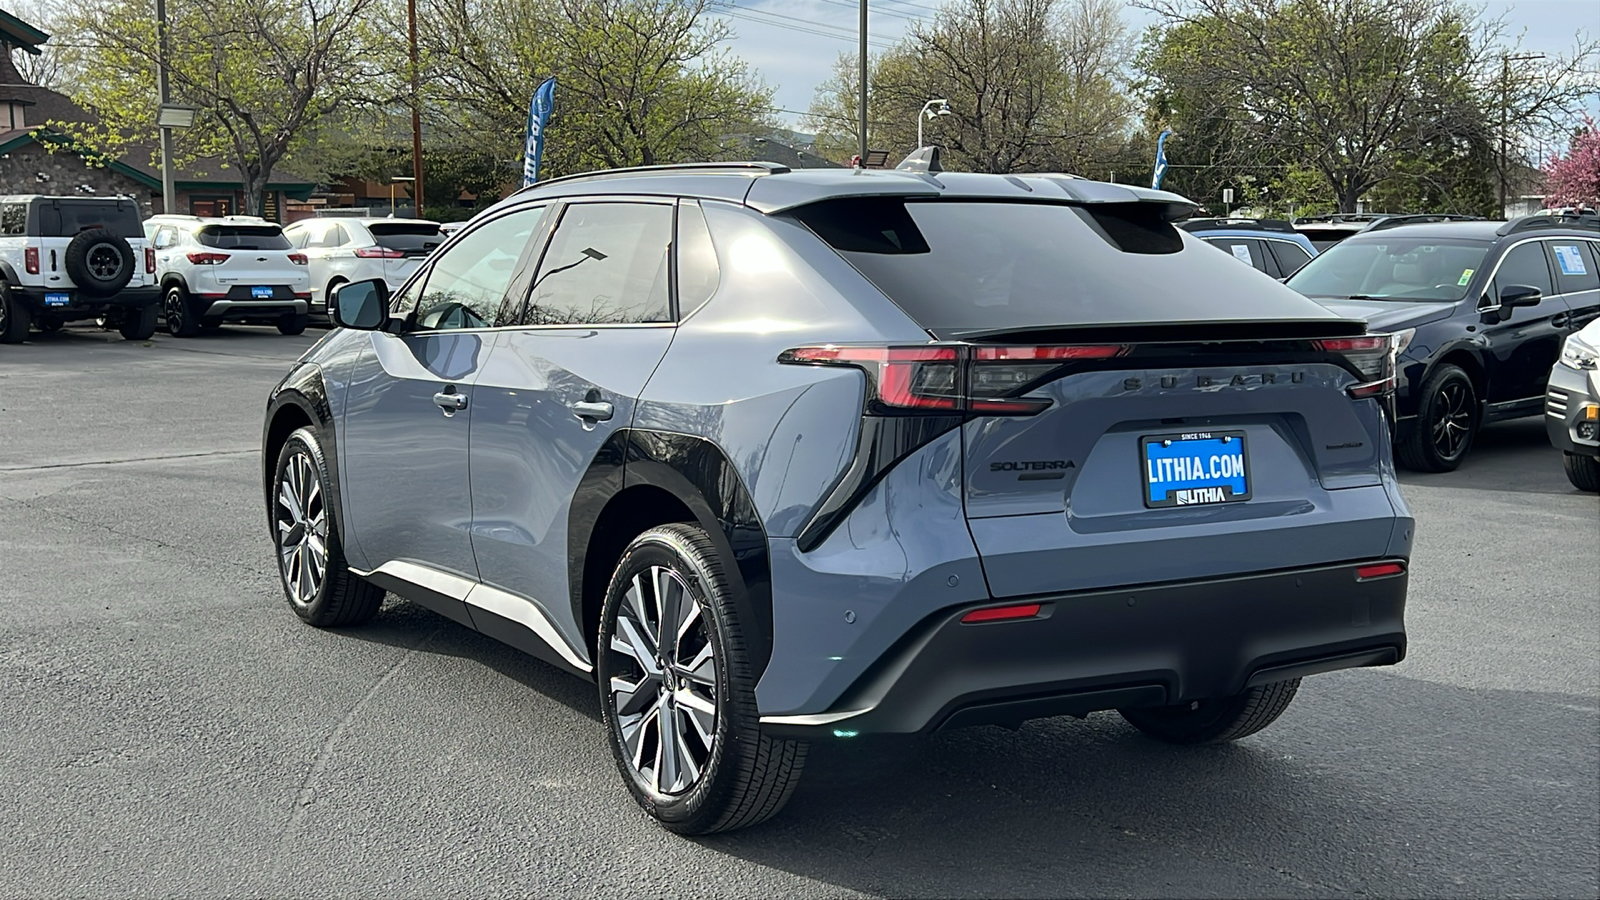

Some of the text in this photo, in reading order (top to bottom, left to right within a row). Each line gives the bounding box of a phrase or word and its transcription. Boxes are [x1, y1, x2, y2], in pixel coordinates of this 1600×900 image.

[1123, 372, 1305, 391] SUBARU
[1198, 432, 1211, 440] 1946
[990, 460, 1076, 472] SOLTERRA
[1147, 453, 1245, 483] LITHIA.COM
[1188, 487, 1225, 503] LITHIA
